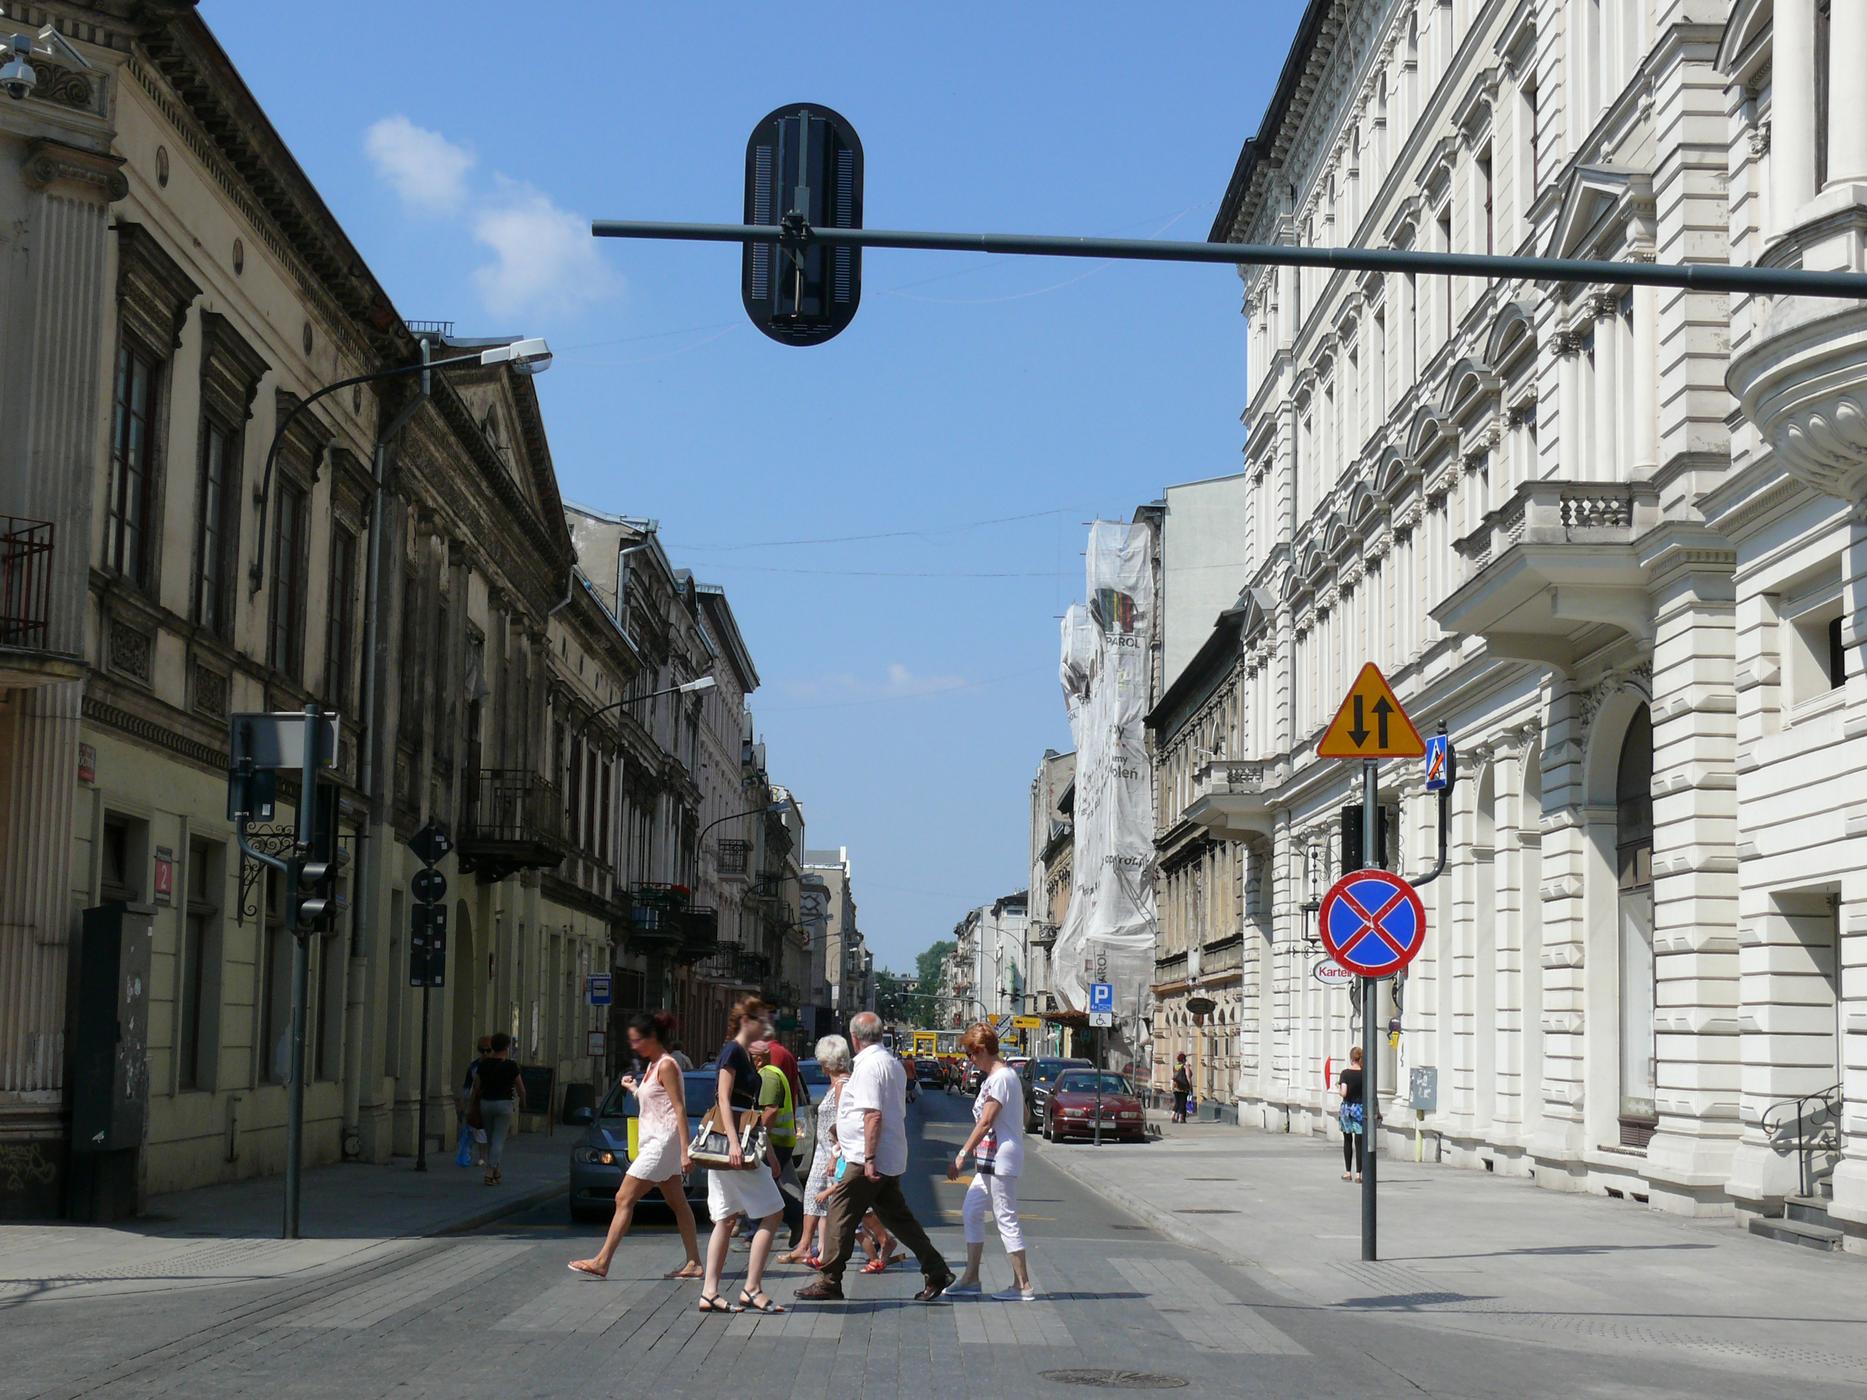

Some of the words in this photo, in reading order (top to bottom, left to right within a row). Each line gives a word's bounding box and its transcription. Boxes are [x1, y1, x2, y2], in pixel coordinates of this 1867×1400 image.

[1105, 636, 1140, 649] PAROL
[160, 863, 167, 889] 2
[1094, 985, 1109, 1004] P
